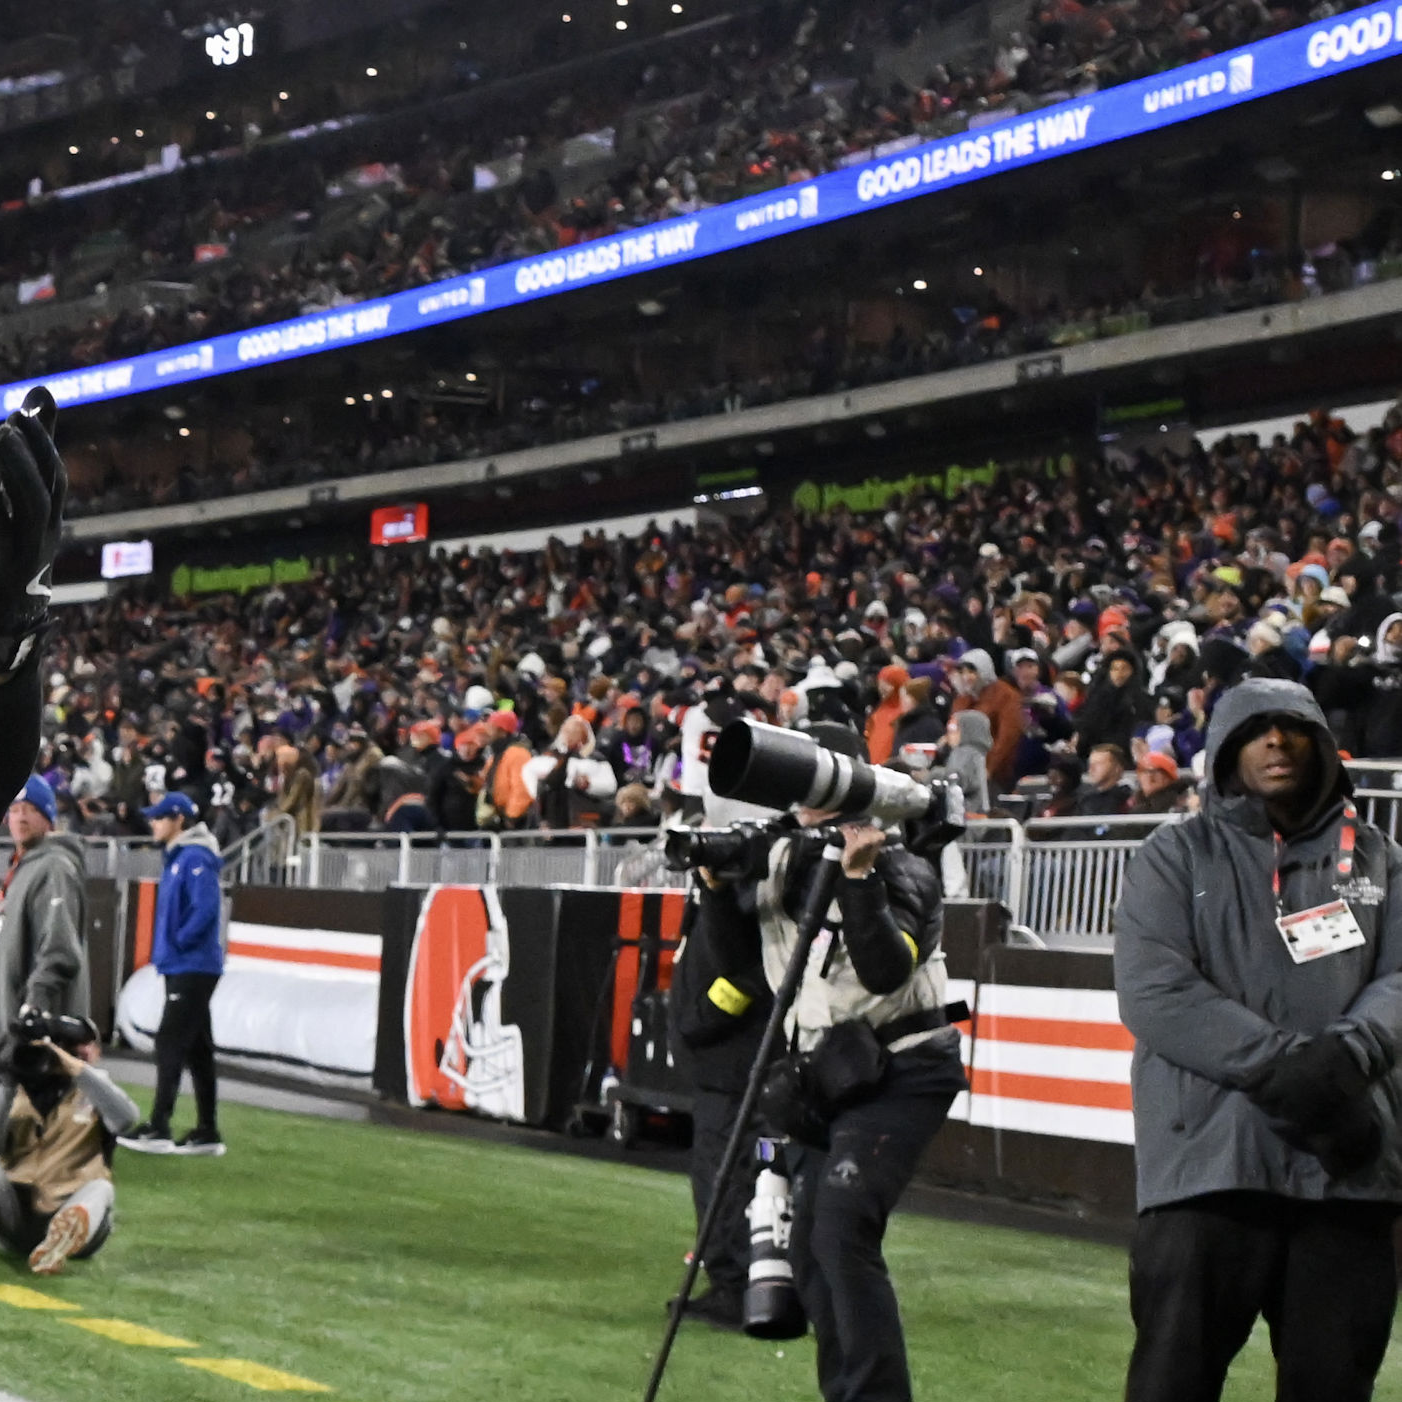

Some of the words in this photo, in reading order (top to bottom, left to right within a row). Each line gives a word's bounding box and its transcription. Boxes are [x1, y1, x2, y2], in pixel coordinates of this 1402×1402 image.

[1307, 11, 1393, 68] GOOD
[1143, 71, 1226, 113] UNITED
[857, 156, 921, 202] GOOD
[922, 135, 992, 184] LEADS
[992, 121, 1036, 163] THE
[1036, 104, 1095, 150] WAY
[735, 198, 798, 231] UNITED
[515, 257, 566, 294] GOOD
[566, 241, 621, 282] LEADS
[621, 232, 655, 267] THE
[655, 220, 700, 259] WAY
